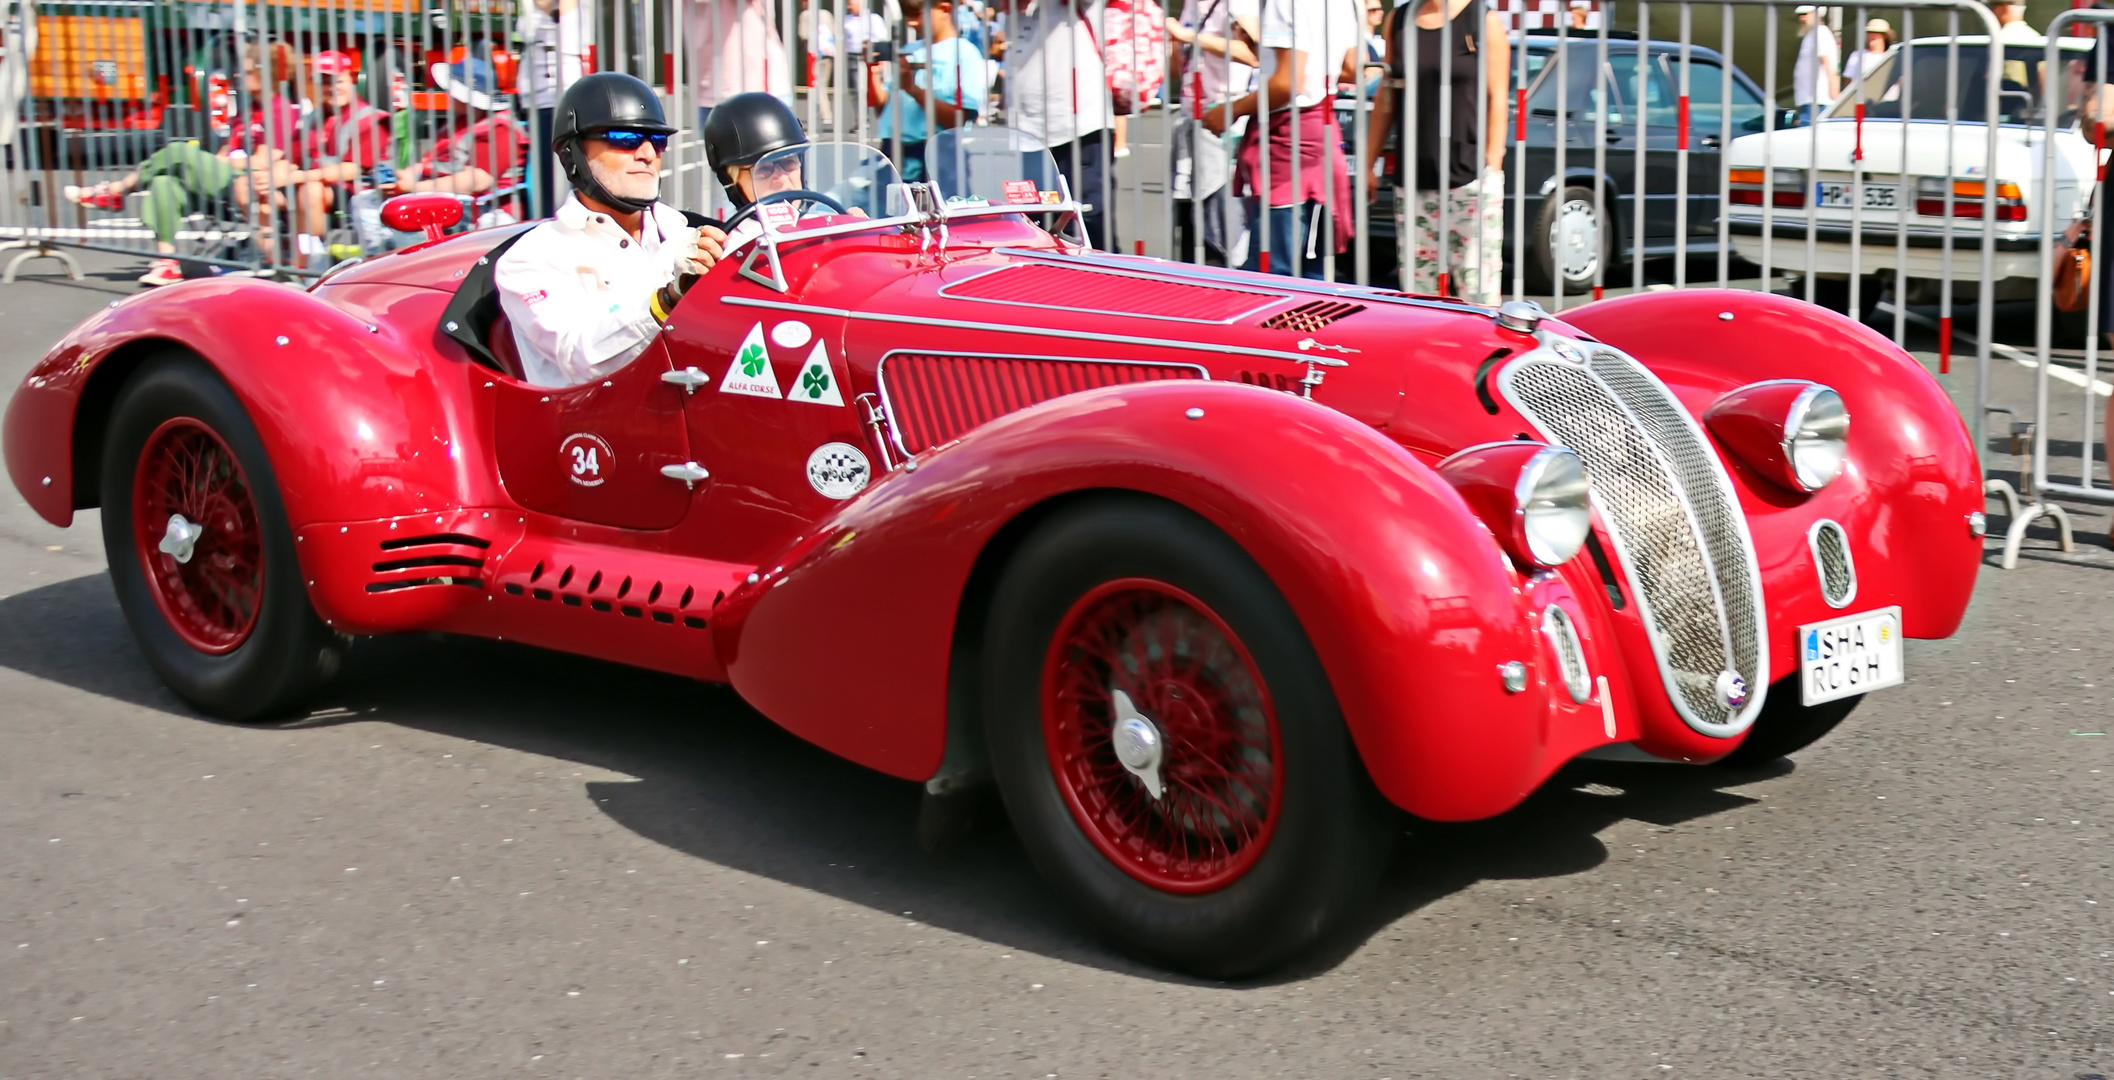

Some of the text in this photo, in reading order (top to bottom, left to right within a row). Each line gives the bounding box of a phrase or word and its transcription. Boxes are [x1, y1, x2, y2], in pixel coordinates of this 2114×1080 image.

[728, 382, 775, 394] ALFA CORSE
[572, 446, 599, 475] 34
[1822, 624, 1865, 660] SHA
